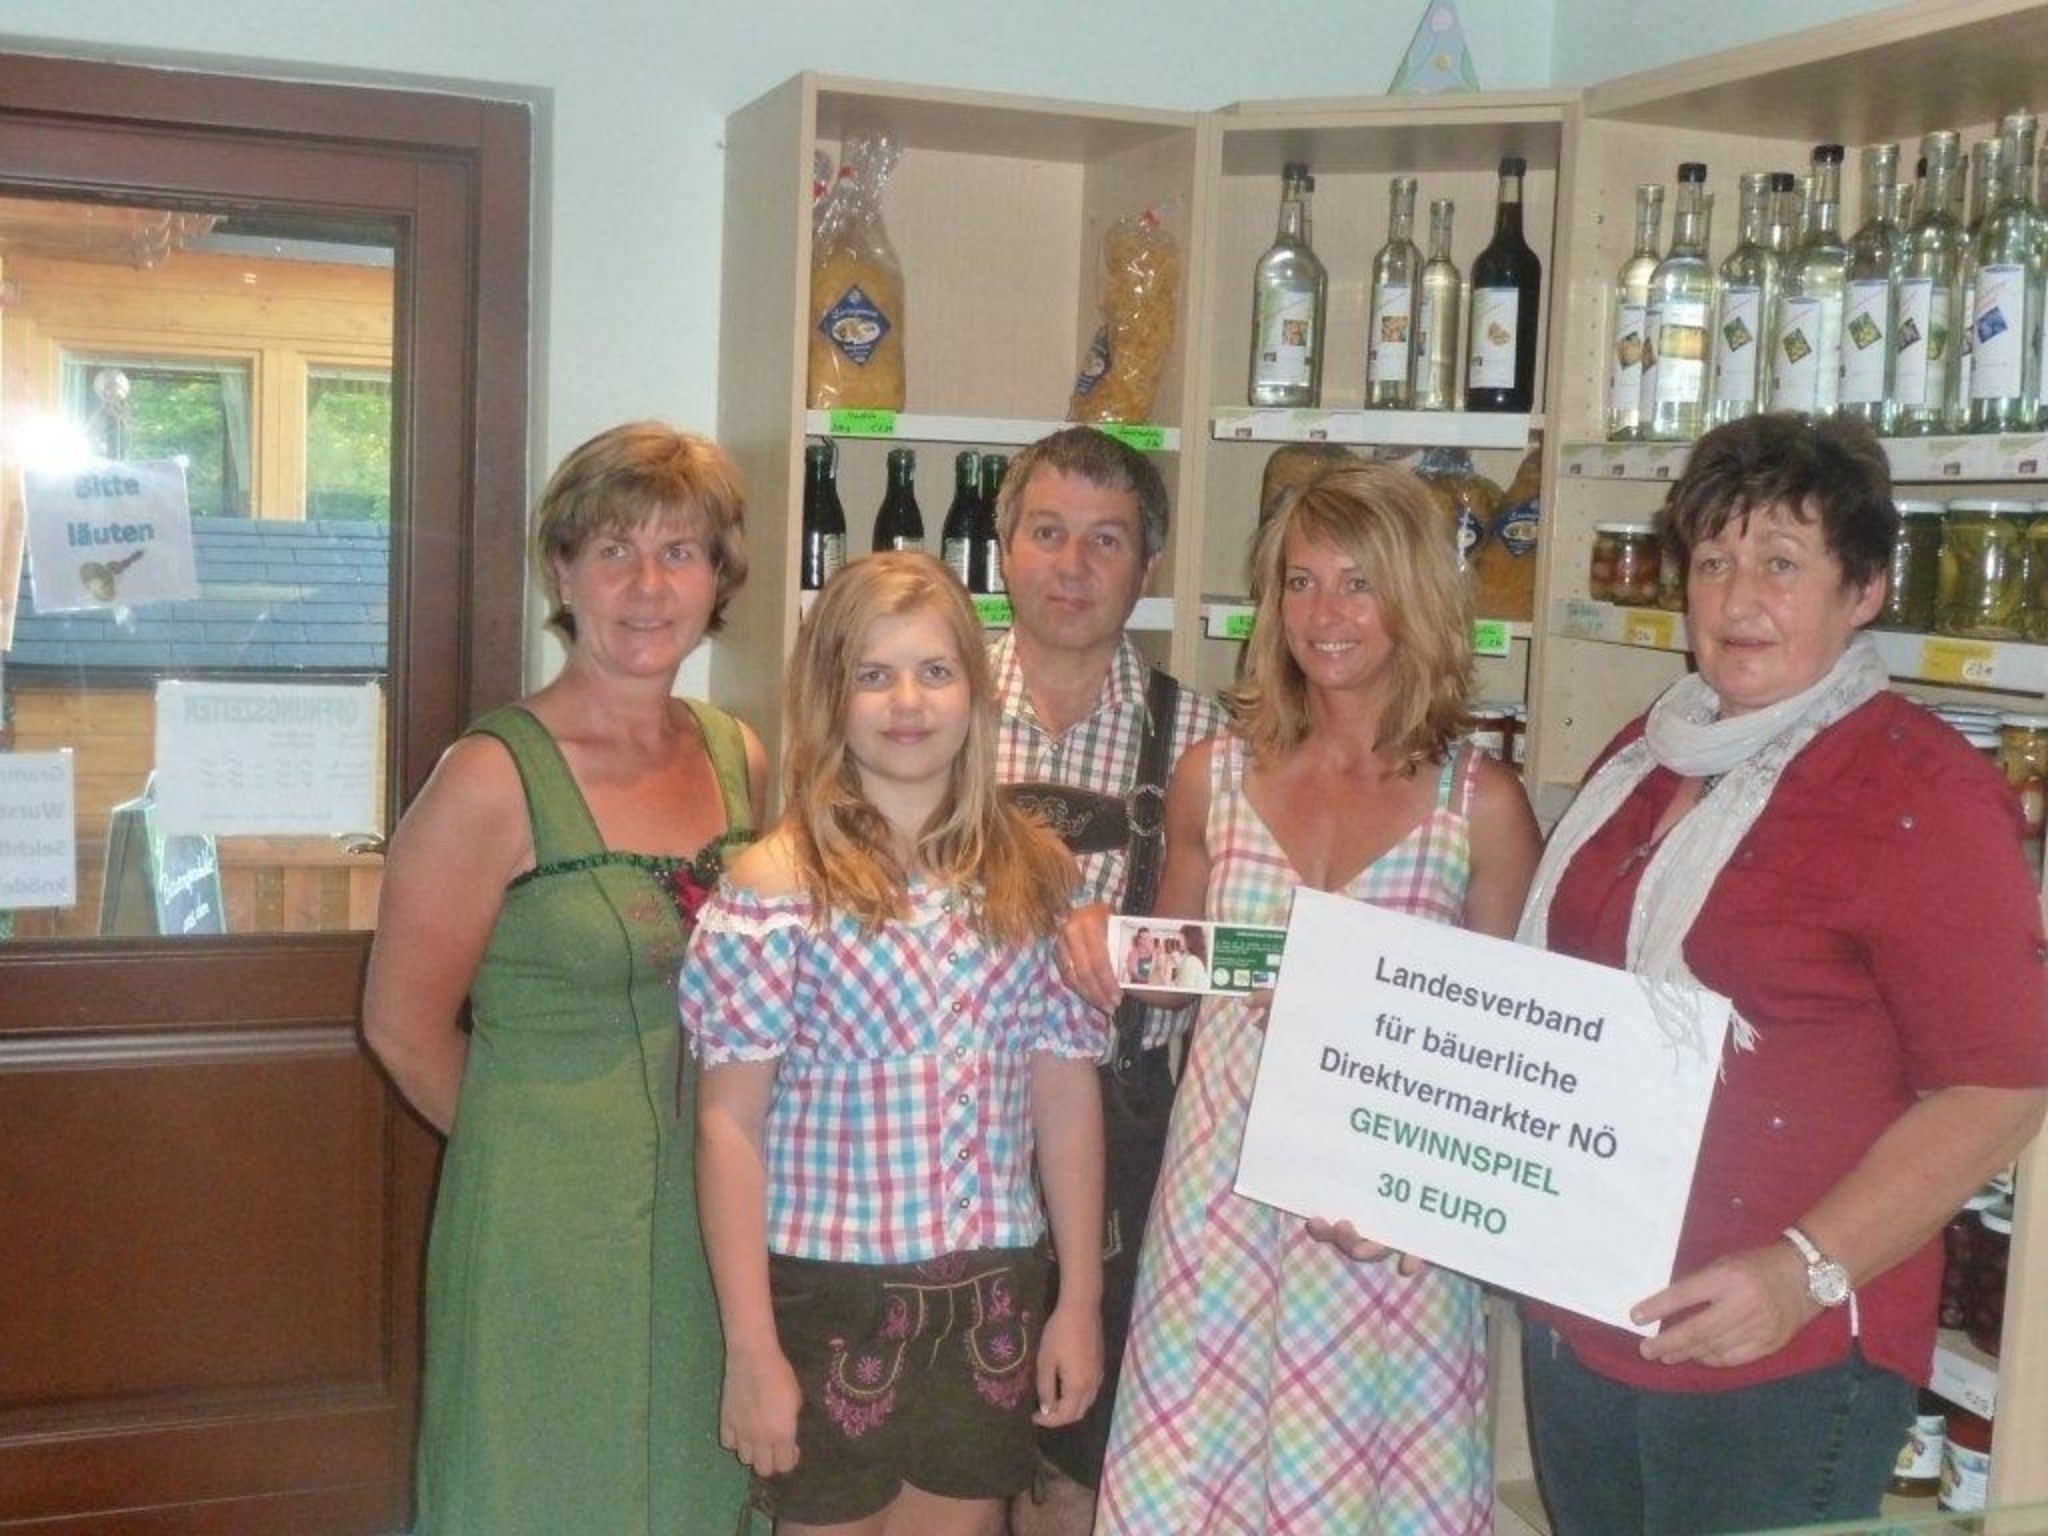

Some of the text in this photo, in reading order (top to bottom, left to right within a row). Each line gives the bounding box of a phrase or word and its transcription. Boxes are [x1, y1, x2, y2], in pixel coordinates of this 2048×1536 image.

[75, 475, 141, 499] Bitte
[67, 521, 155, 547] läuten
[1375, 955, 1606, 1044] Landesverband
[1375, 1012, 1578, 1095] für bäuerliche
[1319, 1045, 1618, 1160] Direktvermarkter NÖ
[1349, 1106, 1561, 1197] GEWINNSPIEL
[1376, 1172, 1507, 1235] 30 EURO
